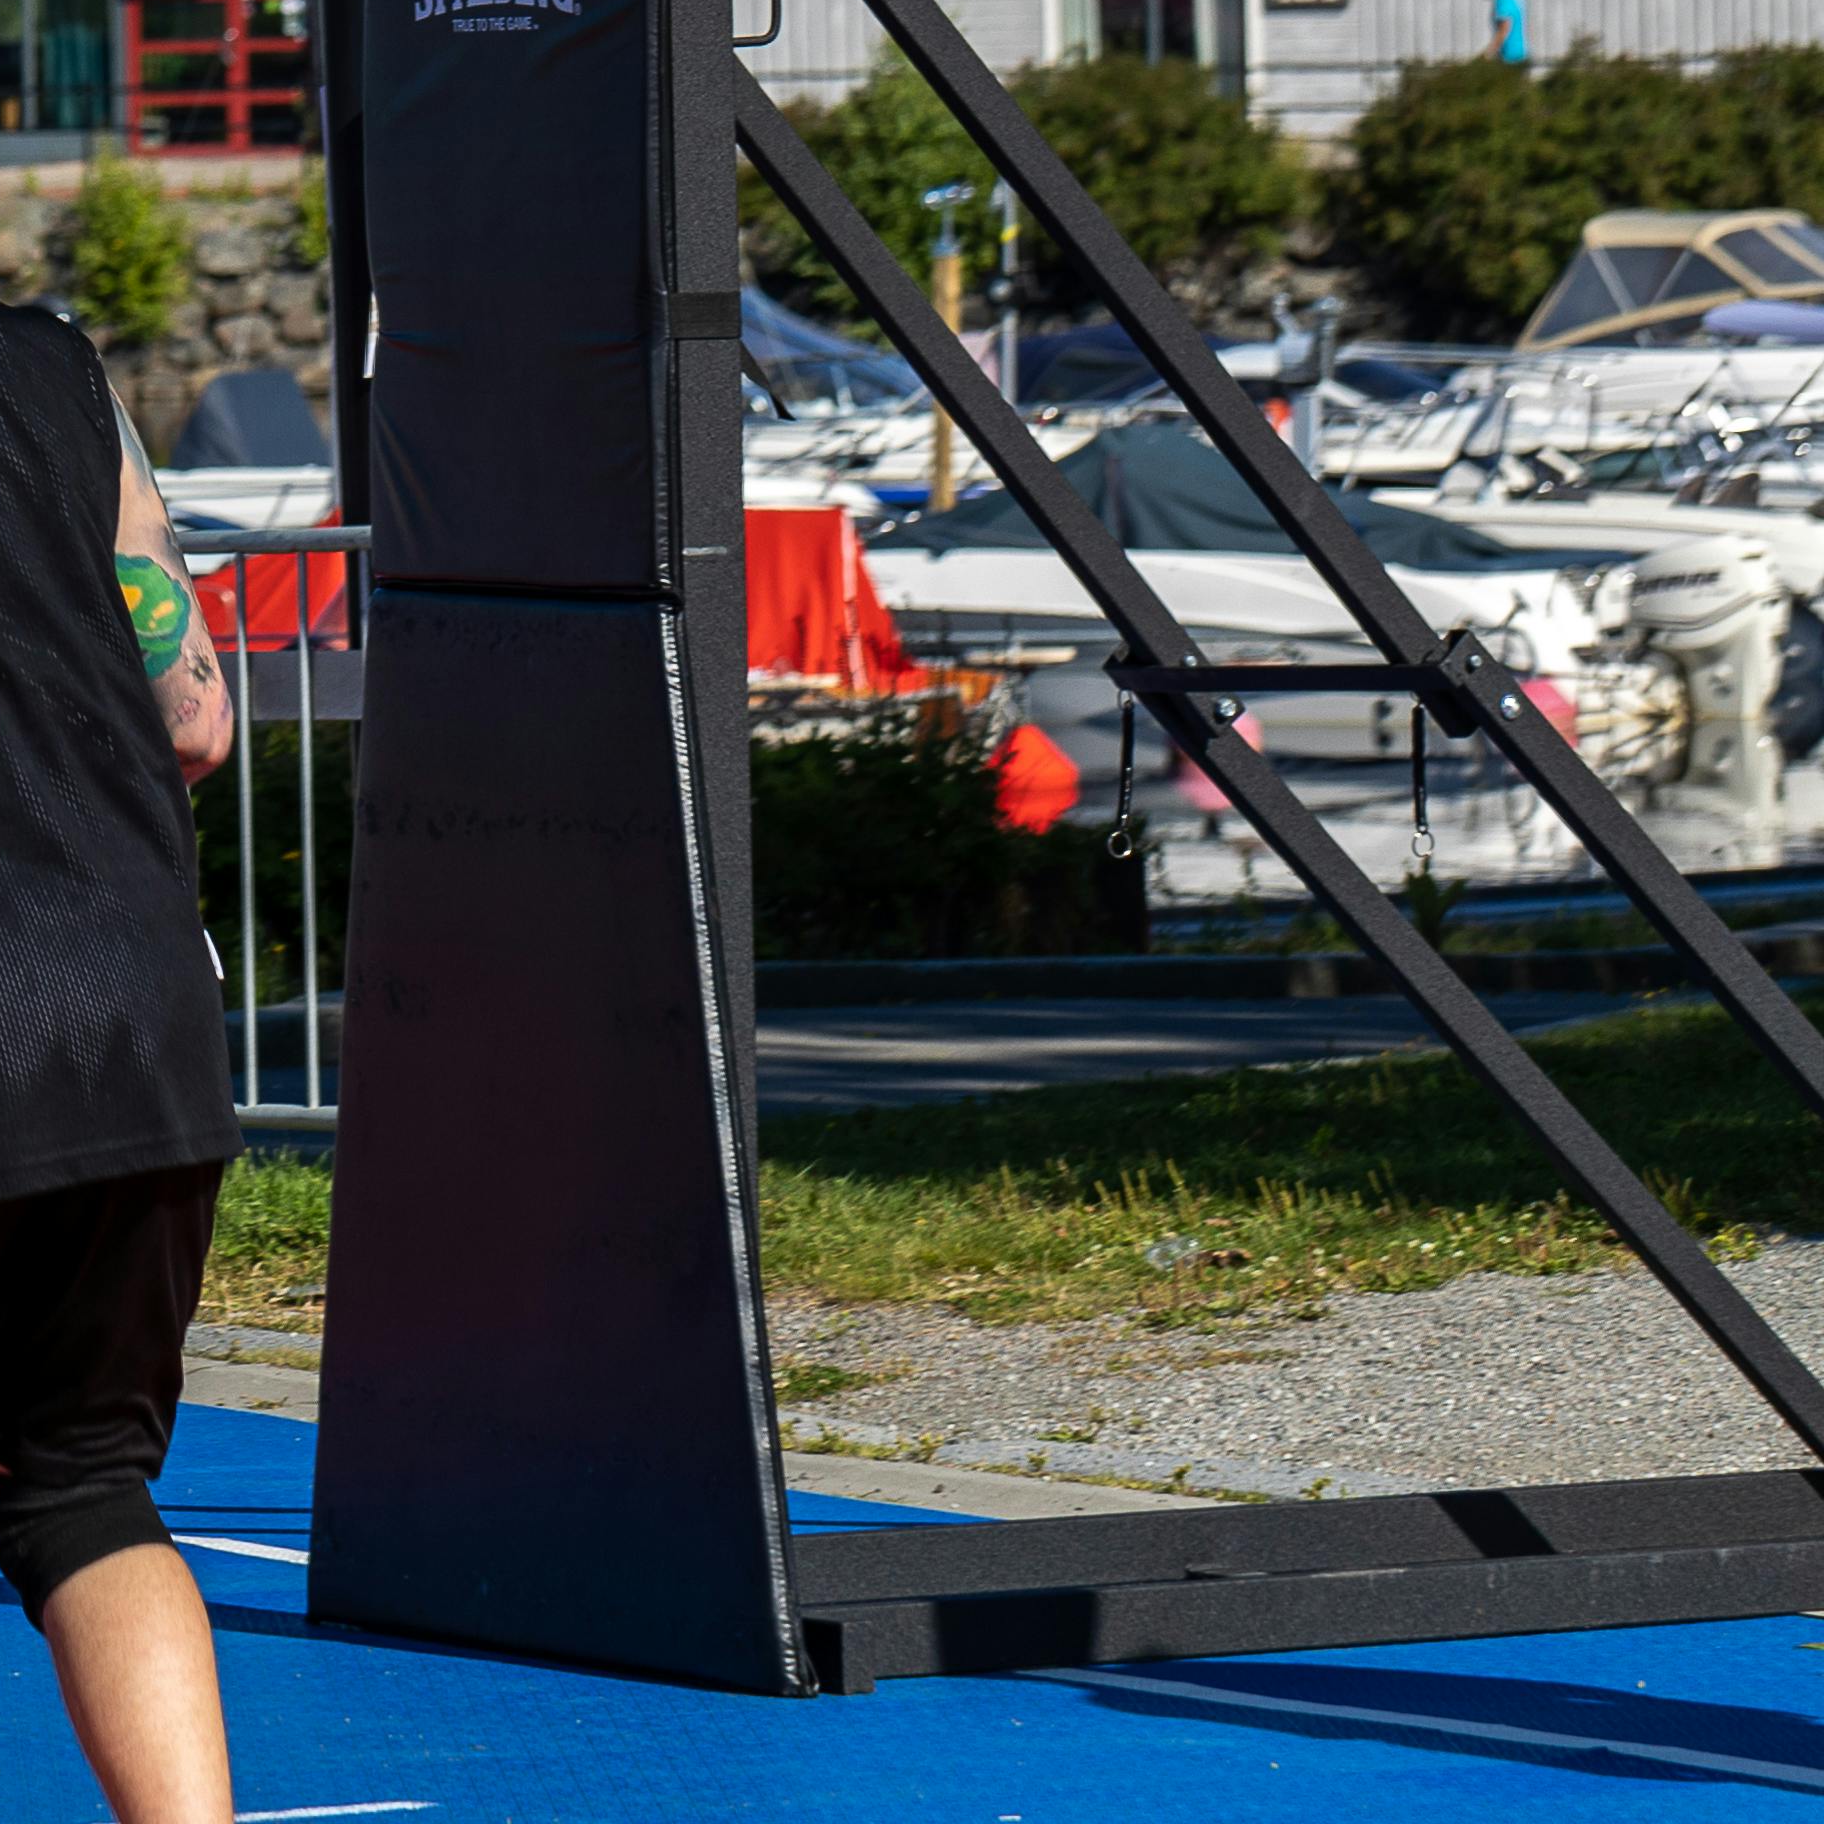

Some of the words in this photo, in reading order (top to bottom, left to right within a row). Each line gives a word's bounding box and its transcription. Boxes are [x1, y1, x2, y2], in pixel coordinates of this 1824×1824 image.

[452, 18, 475, 32] TRUE
[476, 18, 488, 32] TO
[489, 17, 505, 31] THE
